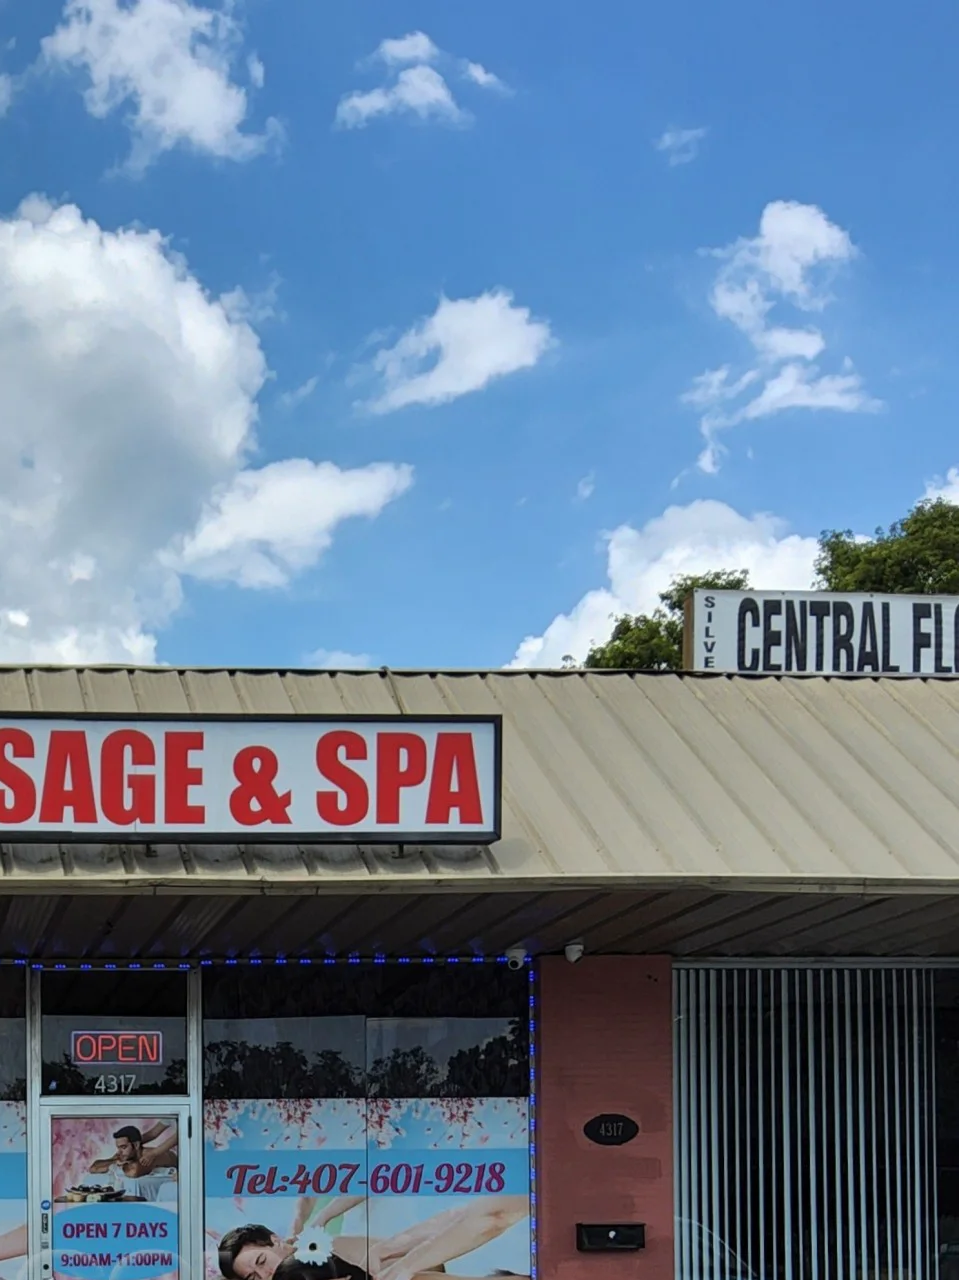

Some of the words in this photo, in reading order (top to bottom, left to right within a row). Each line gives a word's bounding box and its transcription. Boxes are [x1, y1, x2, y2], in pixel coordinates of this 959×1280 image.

[737, 597, 900, 673] CENTRAL
[912, 602, 959, 673] FL
[229, 745, 293, 826] &
[316, 730, 483, 826] SPA
[75, 1033, 158, 1061] OPEN
[94, 1074, 137, 1093] 4317
[599, 1123, 624, 1136] 4317
[226, 1162, 506, 1195] Tel:407-601-9218
[62, 1222, 108, 1239] OPEN
[111, 1222, 122, 1238] 7
[126, 1222, 168, 1238] DAYS
[60, 1253, 173, 1267] 9:00AM-11:00PM
